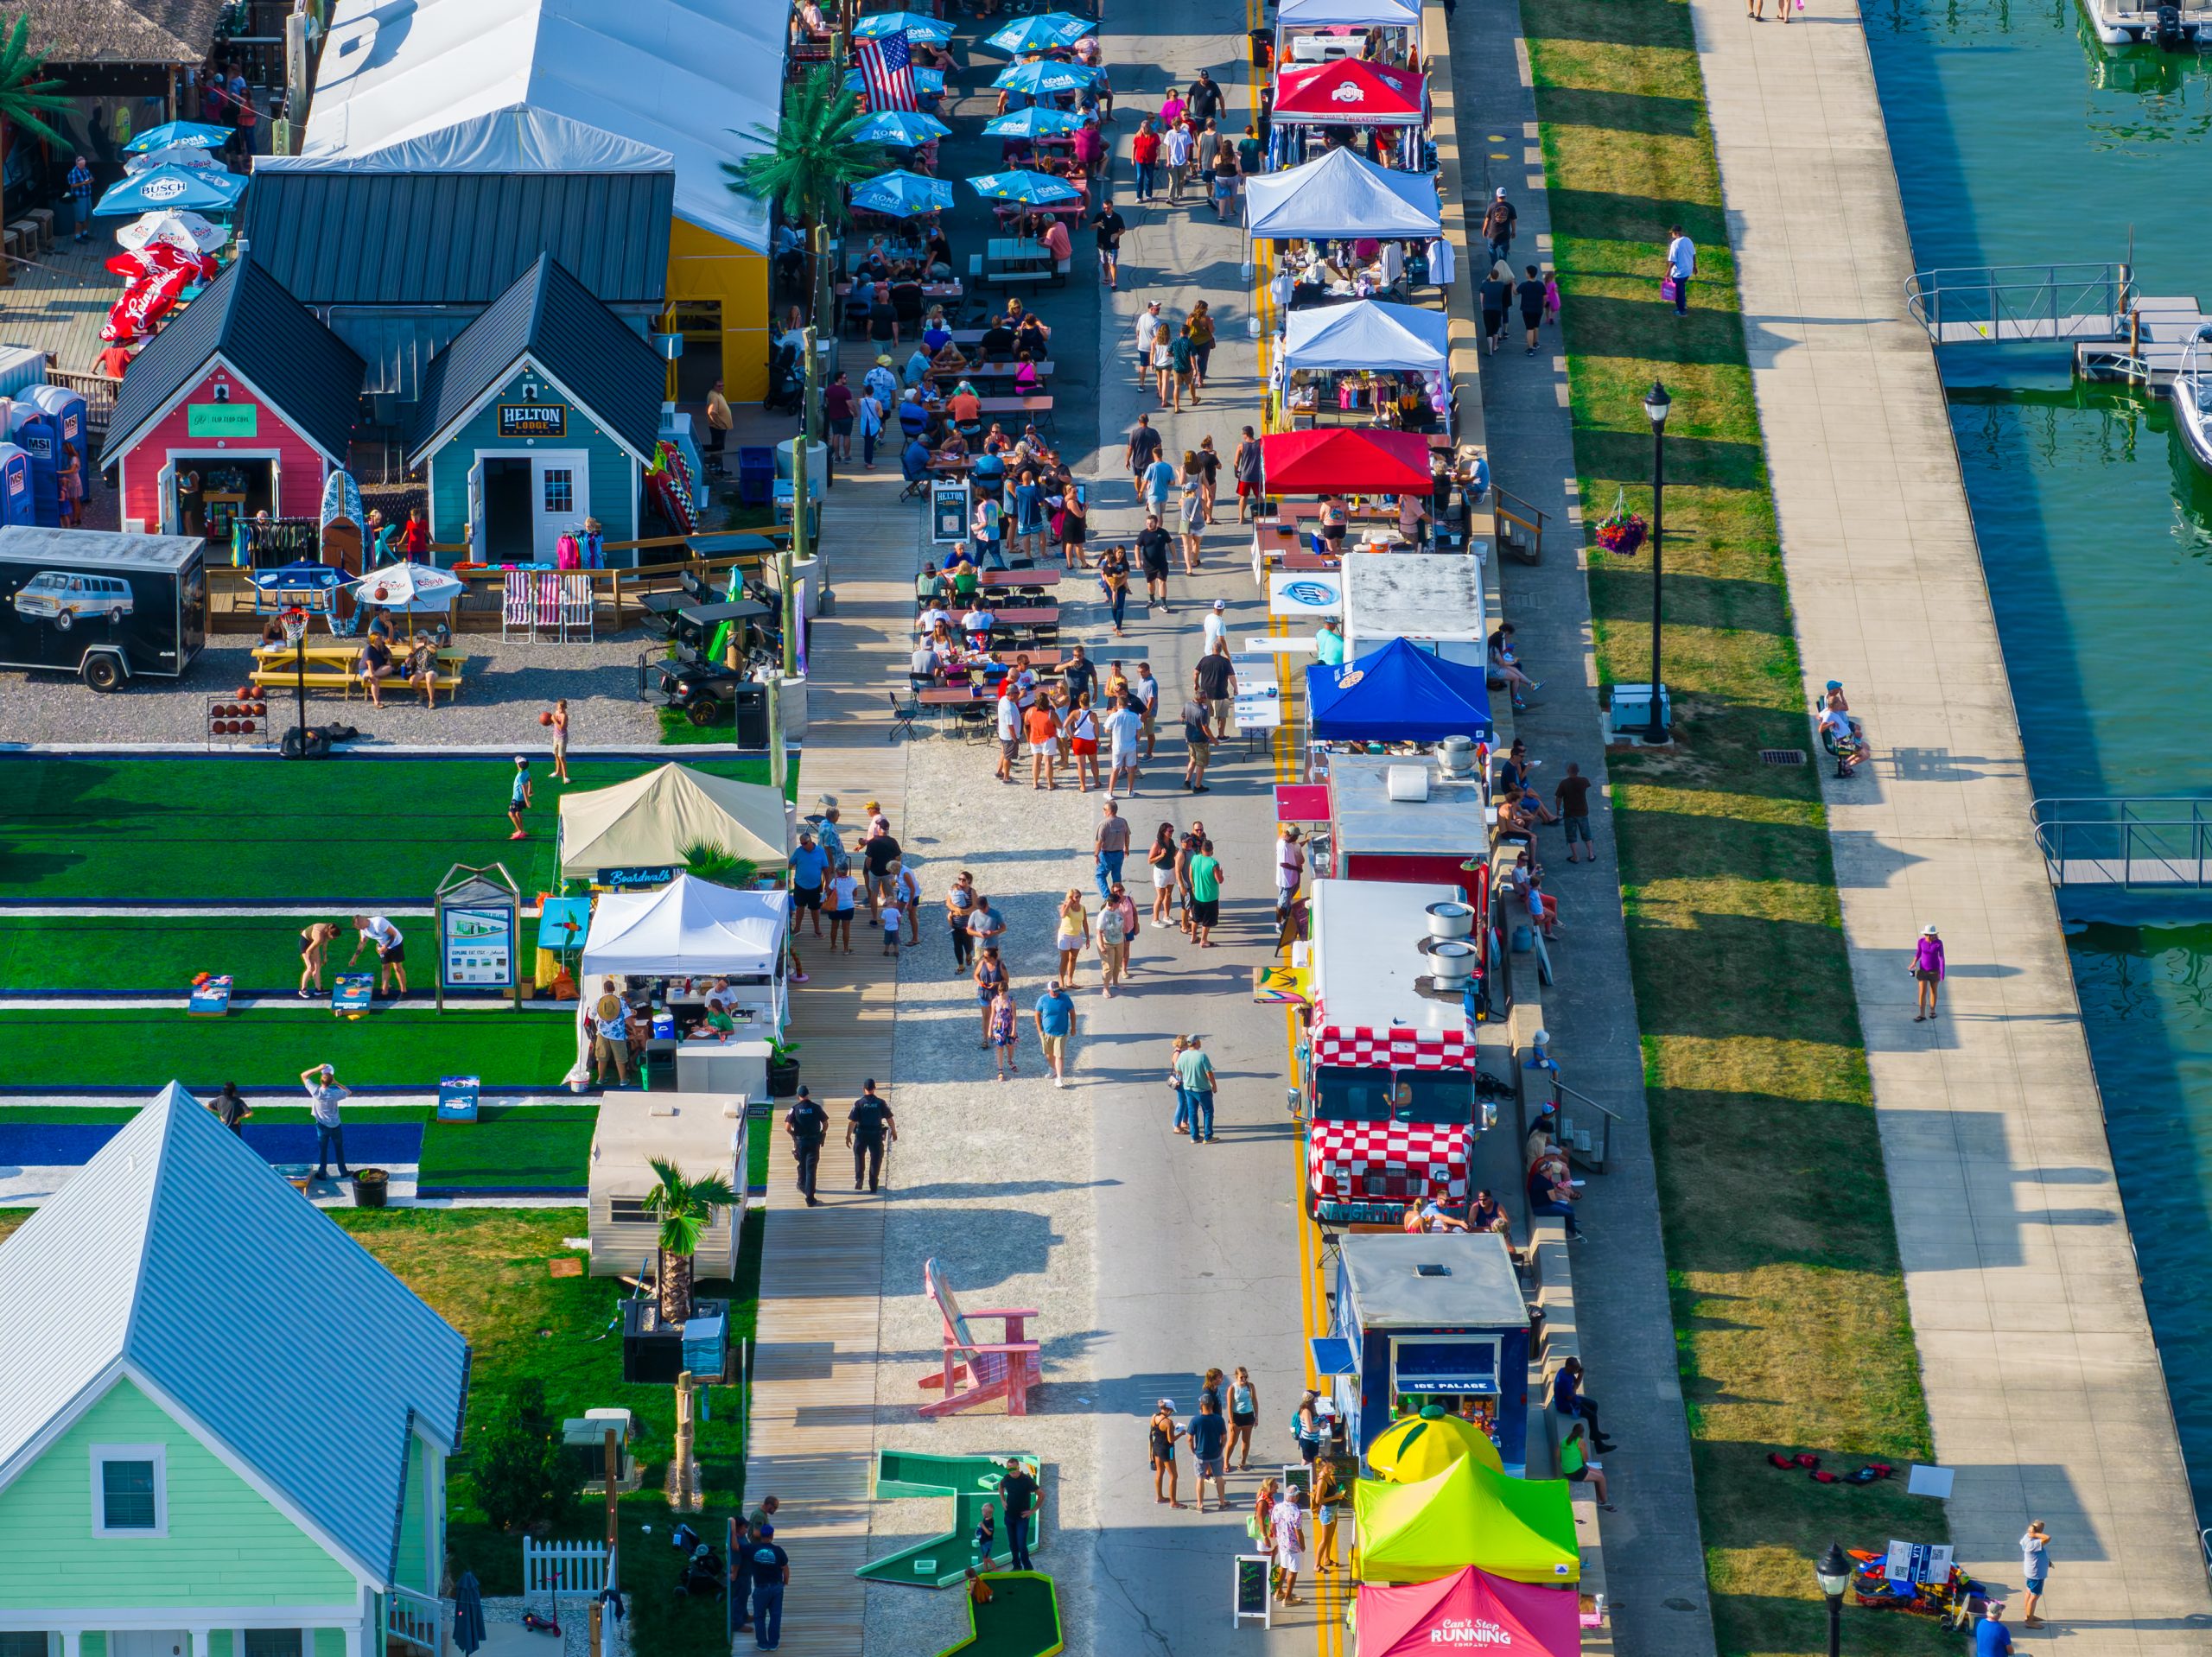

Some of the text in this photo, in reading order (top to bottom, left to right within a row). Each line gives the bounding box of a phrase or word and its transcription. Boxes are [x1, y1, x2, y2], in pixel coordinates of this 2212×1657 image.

[873, 129, 904, 137] KONA
[141, 182, 187, 195] BUSCH
[872, 193, 899, 205] KONA
[158, 232, 185, 242] Coors
[505, 408, 560, 422] HELTON
[65, 416, 78, 429] MSI
[29, 439, 51, 449] MSI
[10, 472, 23, 486] MSI
[938, 492, 964, 501] HELTON
[610, 869, 671, 885] Boardwalk
[1442, 1618, 1500, 1632] Can't Stop
[1431, 1628, 1511, 1645] RUNNING
